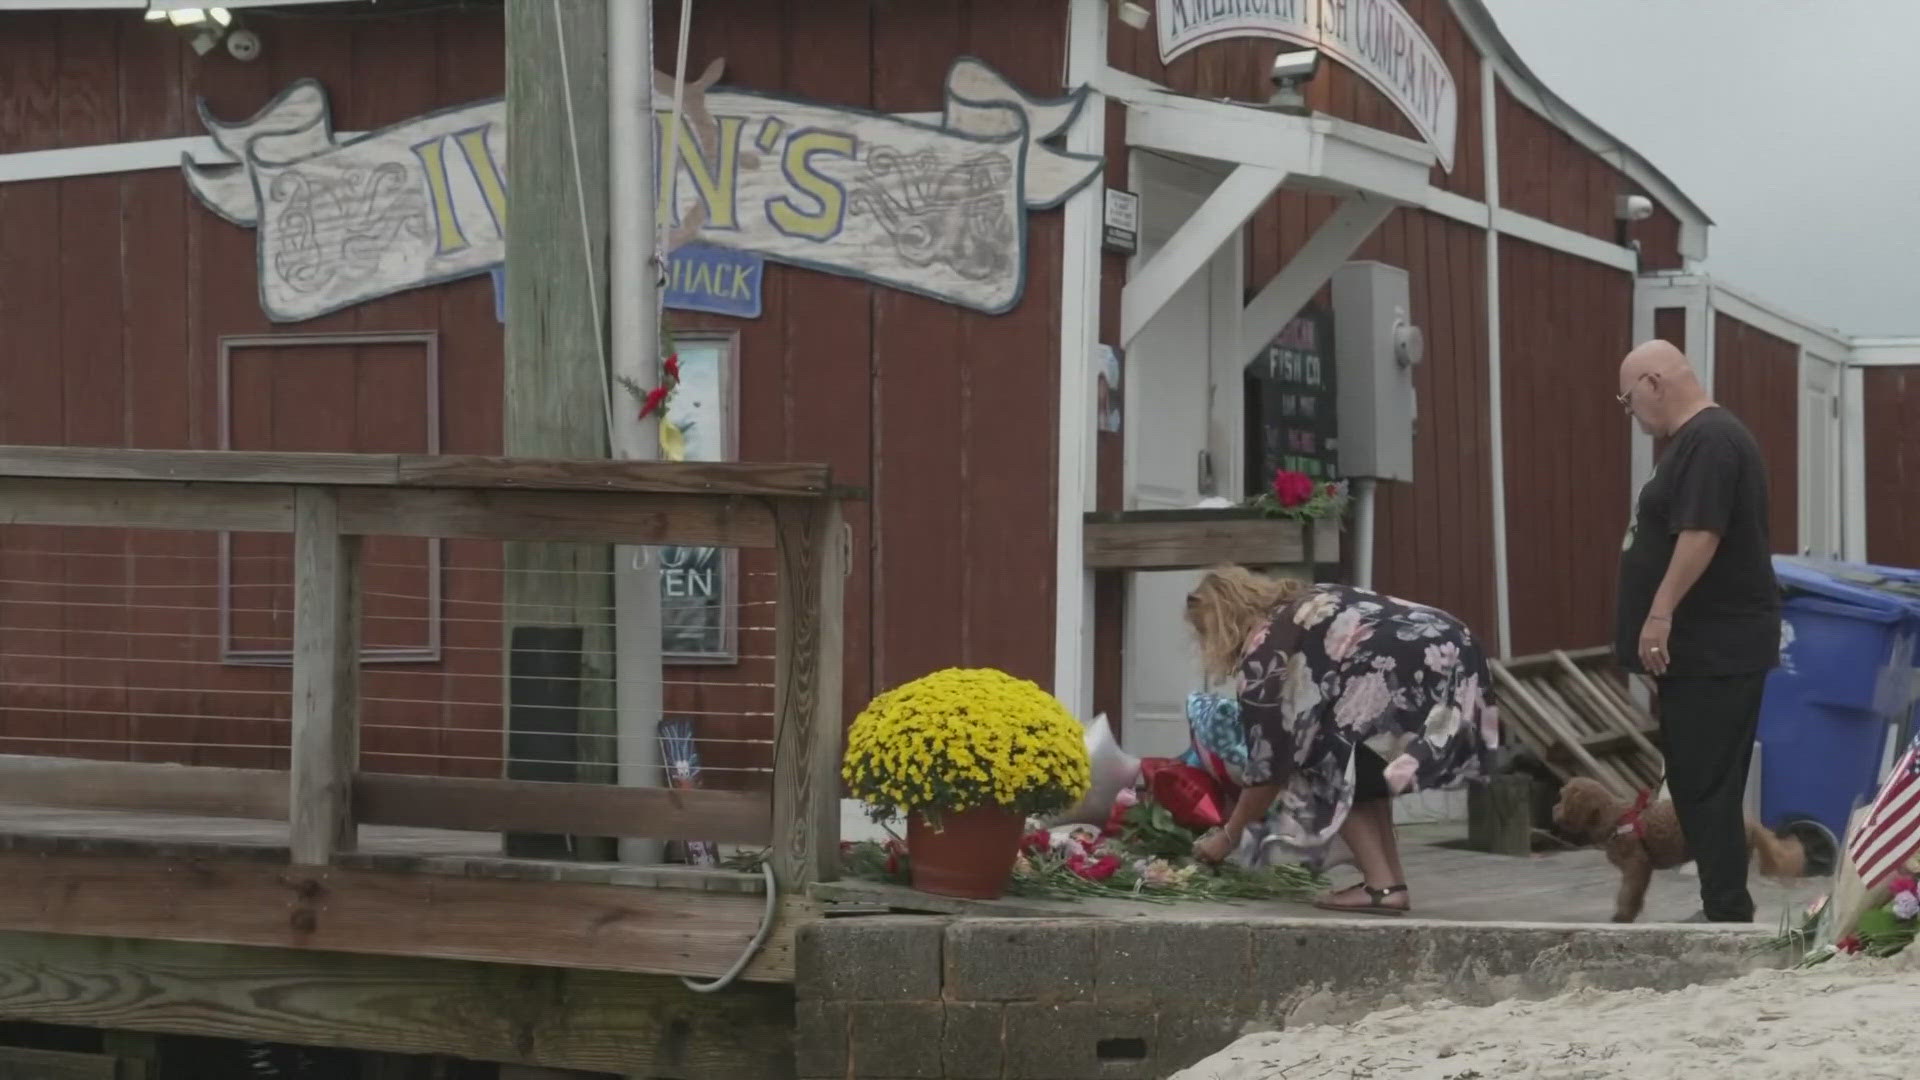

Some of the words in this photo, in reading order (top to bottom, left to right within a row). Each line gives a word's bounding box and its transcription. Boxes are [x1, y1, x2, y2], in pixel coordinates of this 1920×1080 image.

[1356, 0, 1445, 134] COMPANY
[663, 258, 755, 300] HACK
[1269, 348, 1302, 383] FISH
[659, 568, 712, 596] EN
